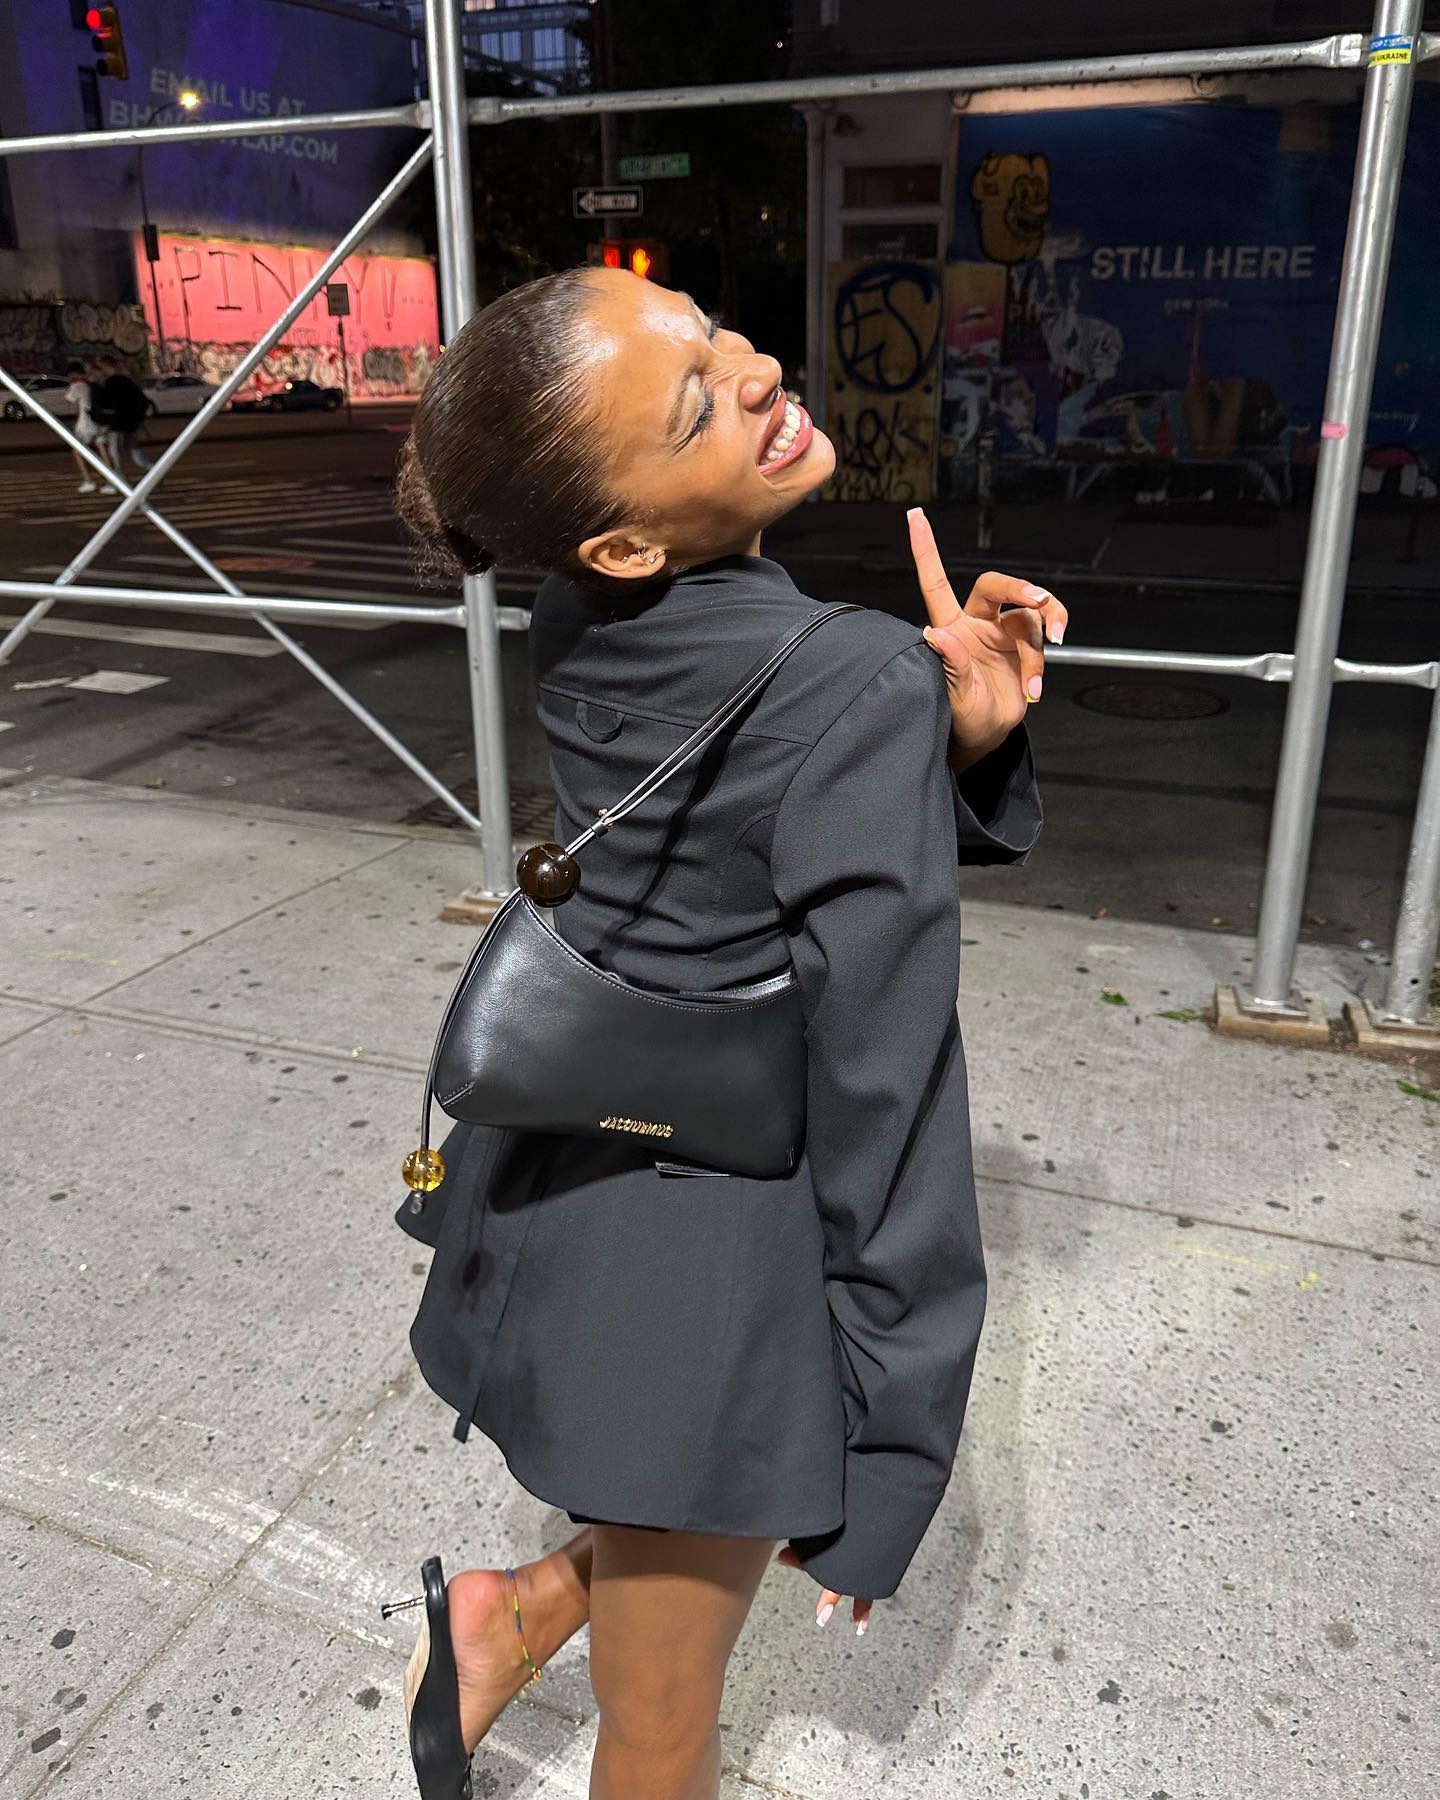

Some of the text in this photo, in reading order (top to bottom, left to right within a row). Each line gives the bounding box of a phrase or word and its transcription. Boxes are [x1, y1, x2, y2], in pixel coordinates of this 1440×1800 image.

[151, 67, 306, 118] EMAIL US AT
[1091, 245, 1195, 281] STILL
[1204, 245, 1316, 280] HERE
[599, 1116, 674, 1138] JACQUEMUS
